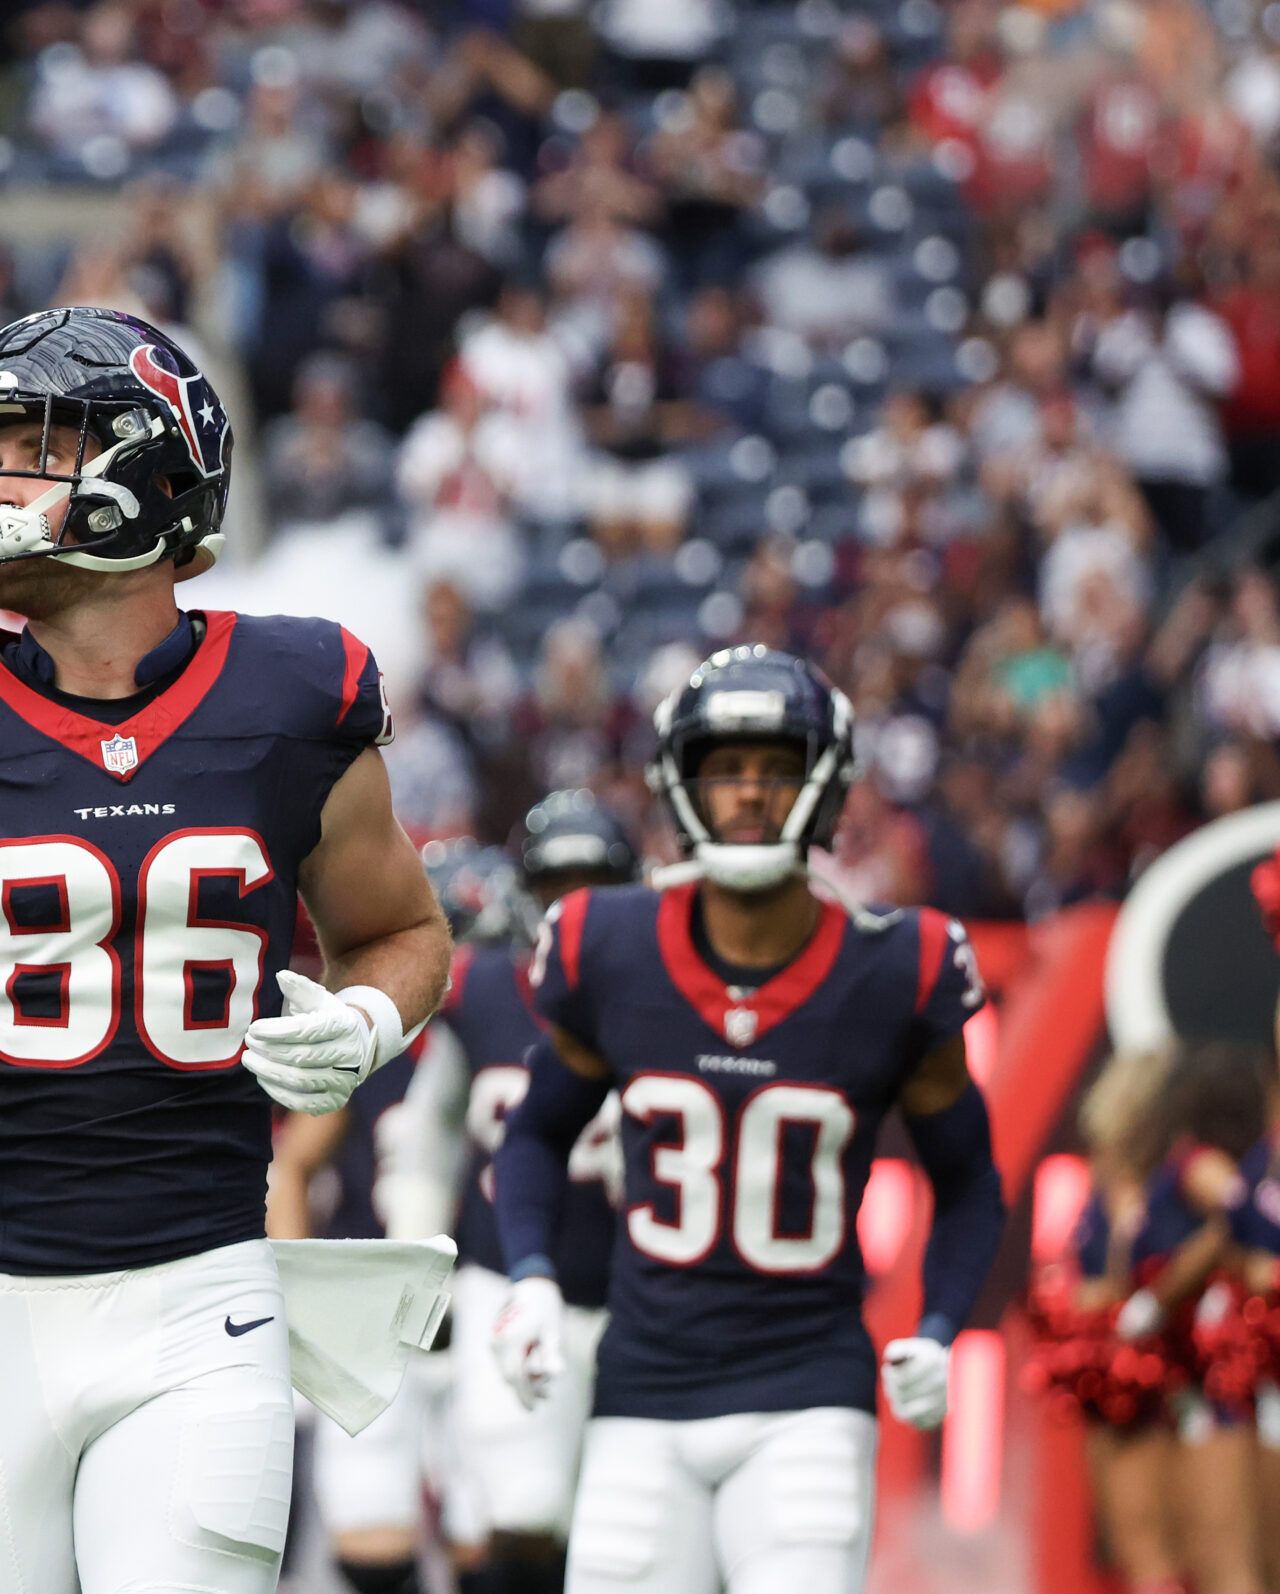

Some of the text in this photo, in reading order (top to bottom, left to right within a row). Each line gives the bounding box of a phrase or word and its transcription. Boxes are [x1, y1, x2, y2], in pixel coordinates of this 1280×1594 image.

[109, 751, 133, 767] NFL
[73, 803, 176, 820] TEXANS
[621, 1069, 857, 1277] 30
